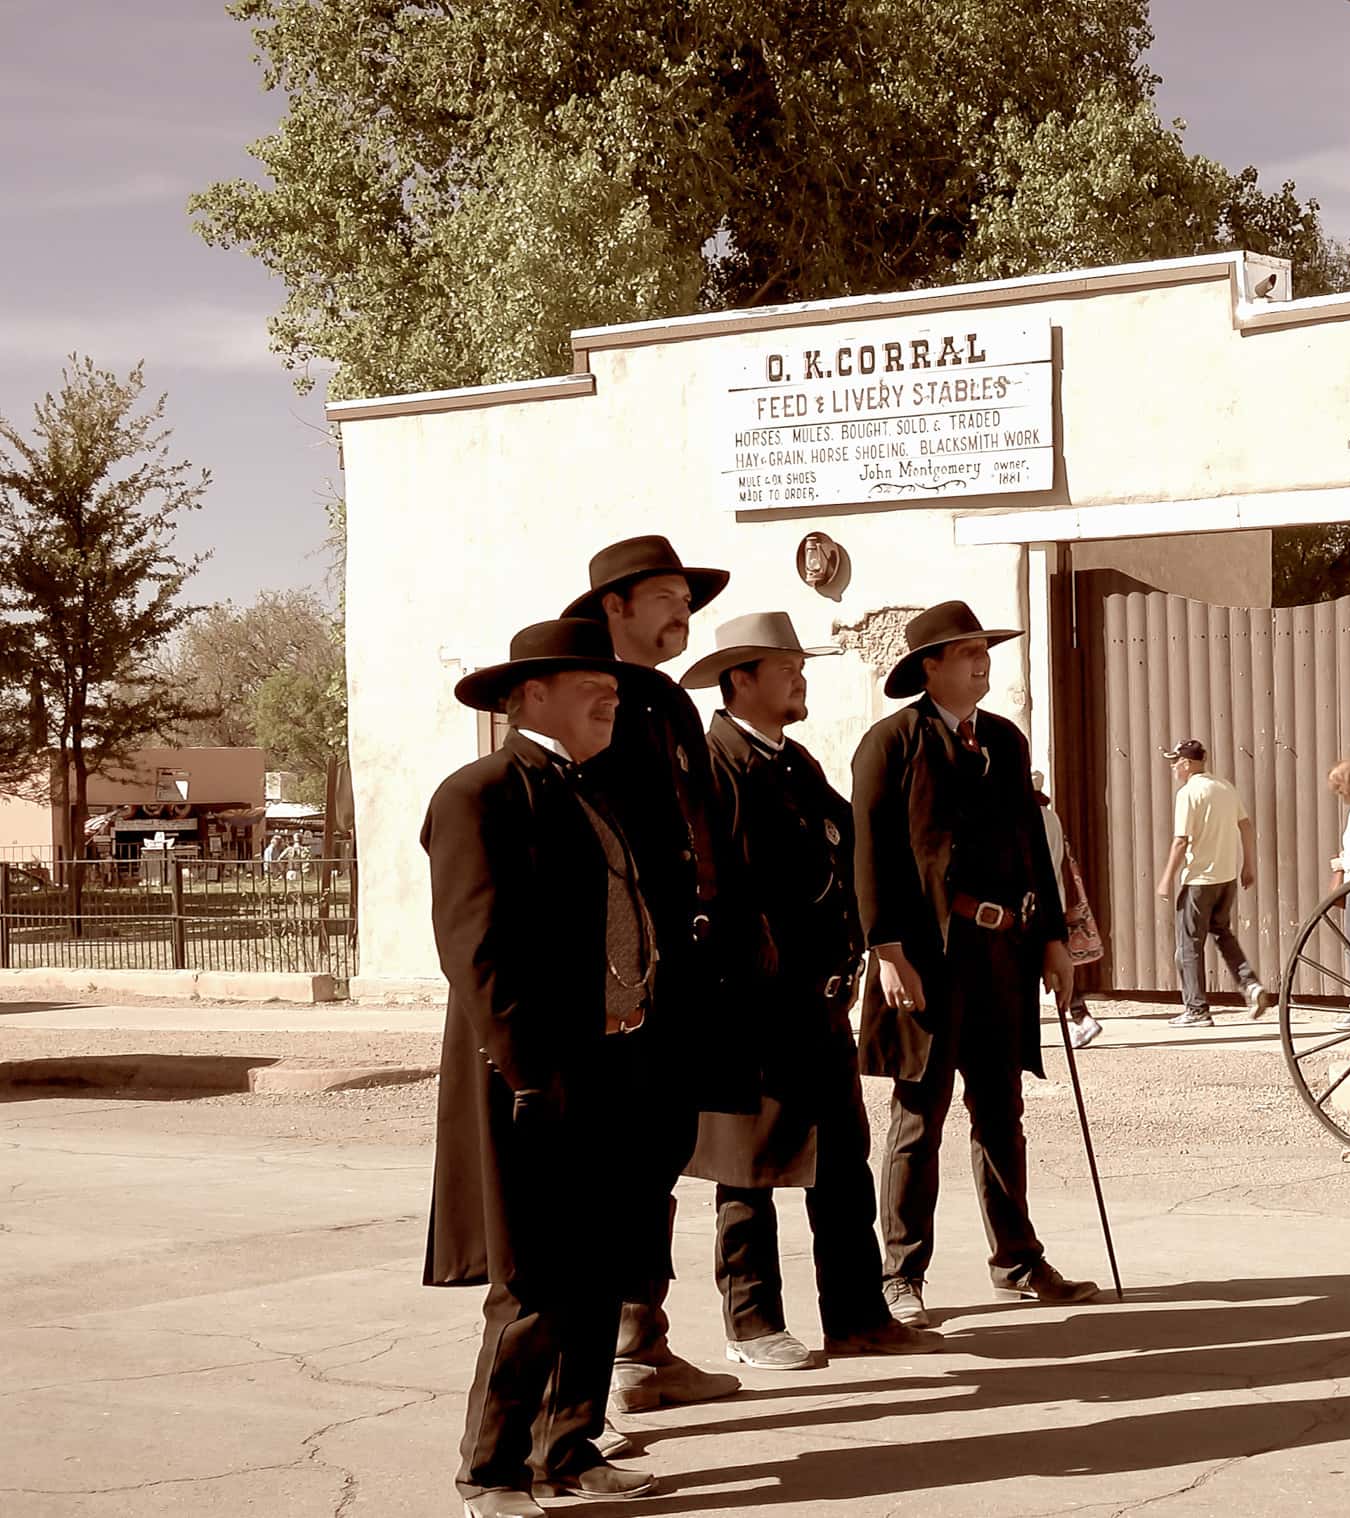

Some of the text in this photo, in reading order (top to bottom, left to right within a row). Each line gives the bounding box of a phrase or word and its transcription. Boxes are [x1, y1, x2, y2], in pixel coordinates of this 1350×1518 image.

[757, 393, 807, 420] FEED
[832, 379, 904, 414] LIVERY
[912, 376, 1007, 407] STABLES
[950, 410, 1001, 430] TRADED
[811, 446, 849, 464] HORSE
[920, 431, 999, 455] BLACKSMITH
[1004, 428, 1040, 447] WORK
[738, 475, 761, 488] MULE
[786, 471, 817, 485] SHOES
[859, 464, 892, 481] John
[899, 459, 982, 482] Montgomery
[999, 472, 1021, 485] 1881
[738, 489, 763, 502] MADE
[769, 489, 780, 501] TO
